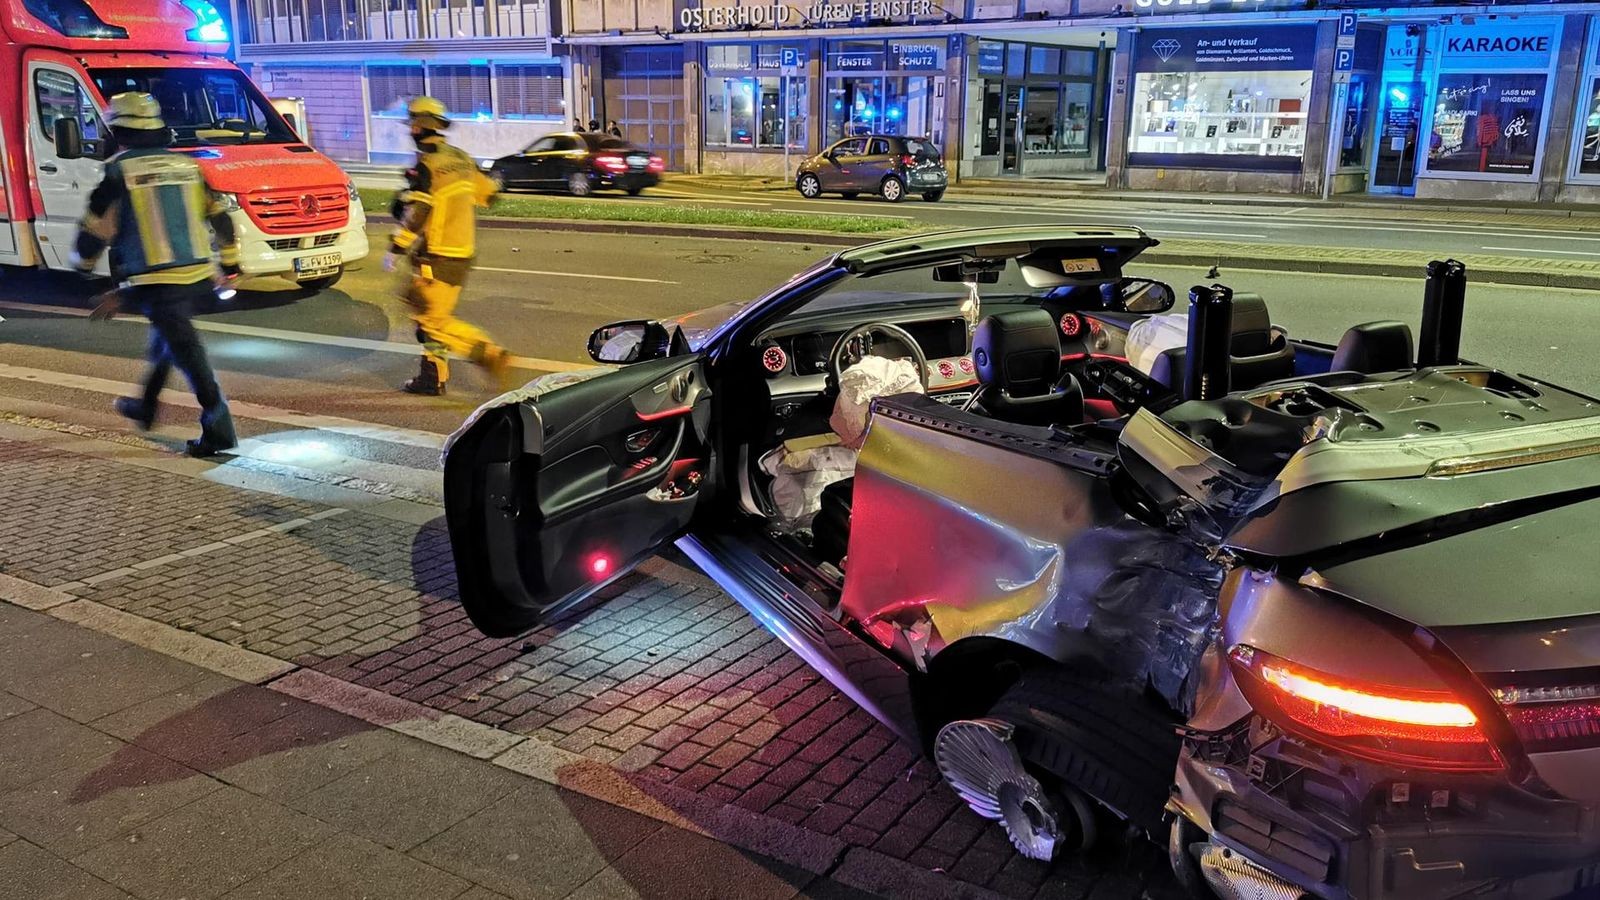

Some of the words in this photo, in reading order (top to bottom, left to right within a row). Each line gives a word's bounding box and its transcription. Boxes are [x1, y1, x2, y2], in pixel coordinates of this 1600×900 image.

[680, 5, 790, 27] OSTERHOLD
[1342, 15, 1354, 33] P
[1197, 39, 1210, 47] An-
[1211, 39, 1226, 47] und
[1228, 37, 1258, 47] Verkauf
[1448, 36, 1549, 52] KARAOKE
[784, 50, 794, 65] P
[836, 56, 872, 67] FENSTER
[898, 56, 933, 66] SCHUTZ
[1338, 50, 1350, 69] P
